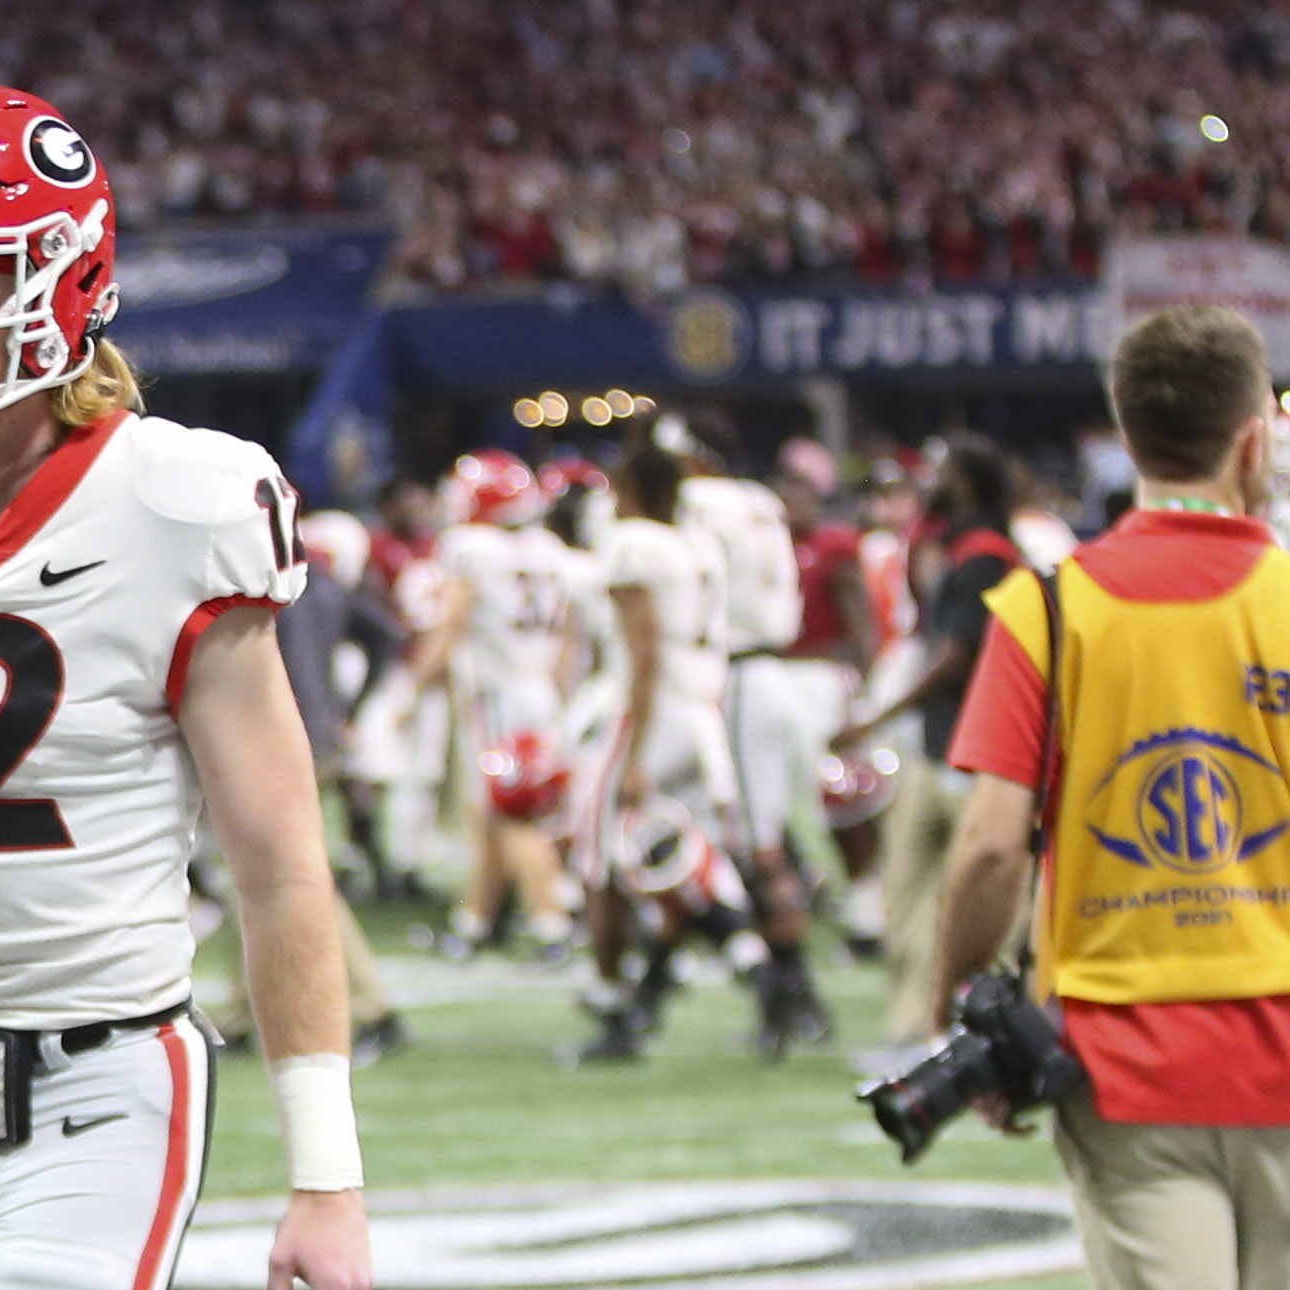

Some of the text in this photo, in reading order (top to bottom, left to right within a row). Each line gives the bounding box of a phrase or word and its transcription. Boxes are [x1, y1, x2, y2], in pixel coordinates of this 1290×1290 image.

[758, 298, 829, 373] IT
[834, 297, 1001, 371] JUST
[1148, 757, 1232, 864] SEC
